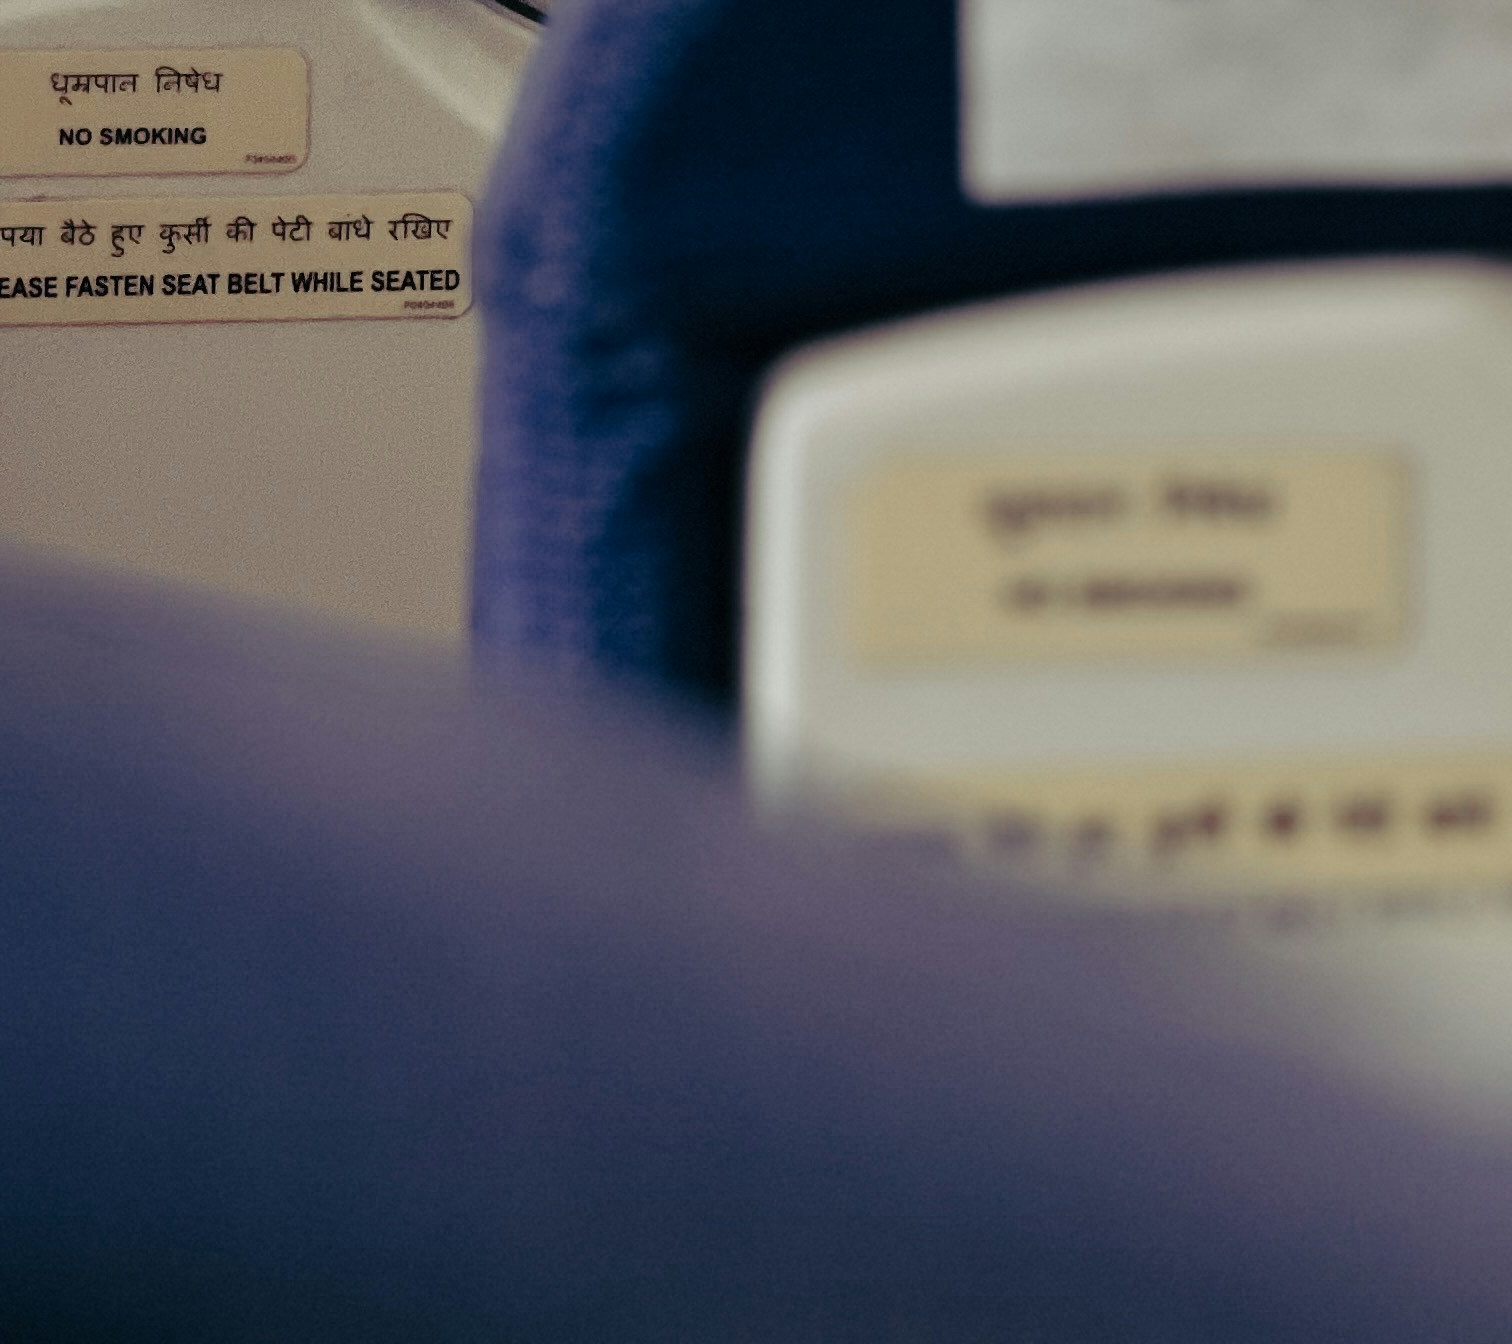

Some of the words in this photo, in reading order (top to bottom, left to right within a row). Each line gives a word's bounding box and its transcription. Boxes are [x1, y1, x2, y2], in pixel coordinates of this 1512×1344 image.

[155, 65, 224, 94] निषेध
[59, 127, 93, 146] NO
[99, 127, 207, 146] SMOKING
[59, 218, 98, 246] बैठे
[110, 224, 146, 258] हुए
[159, 216, 213, 254] कुर्सी
[226, 216, 258, 243] की
[271, 214, 314, 242] पेटी
[388, 212, 454, 241] रखिए
[65, 274, 155, 298] FASTEN
[161, 273, 220, 297] SEAT
[227, 272, 285, 295] BELT
[291, 270, 364, 294] WHILE
[371, 269, 461, 292] SEATED
